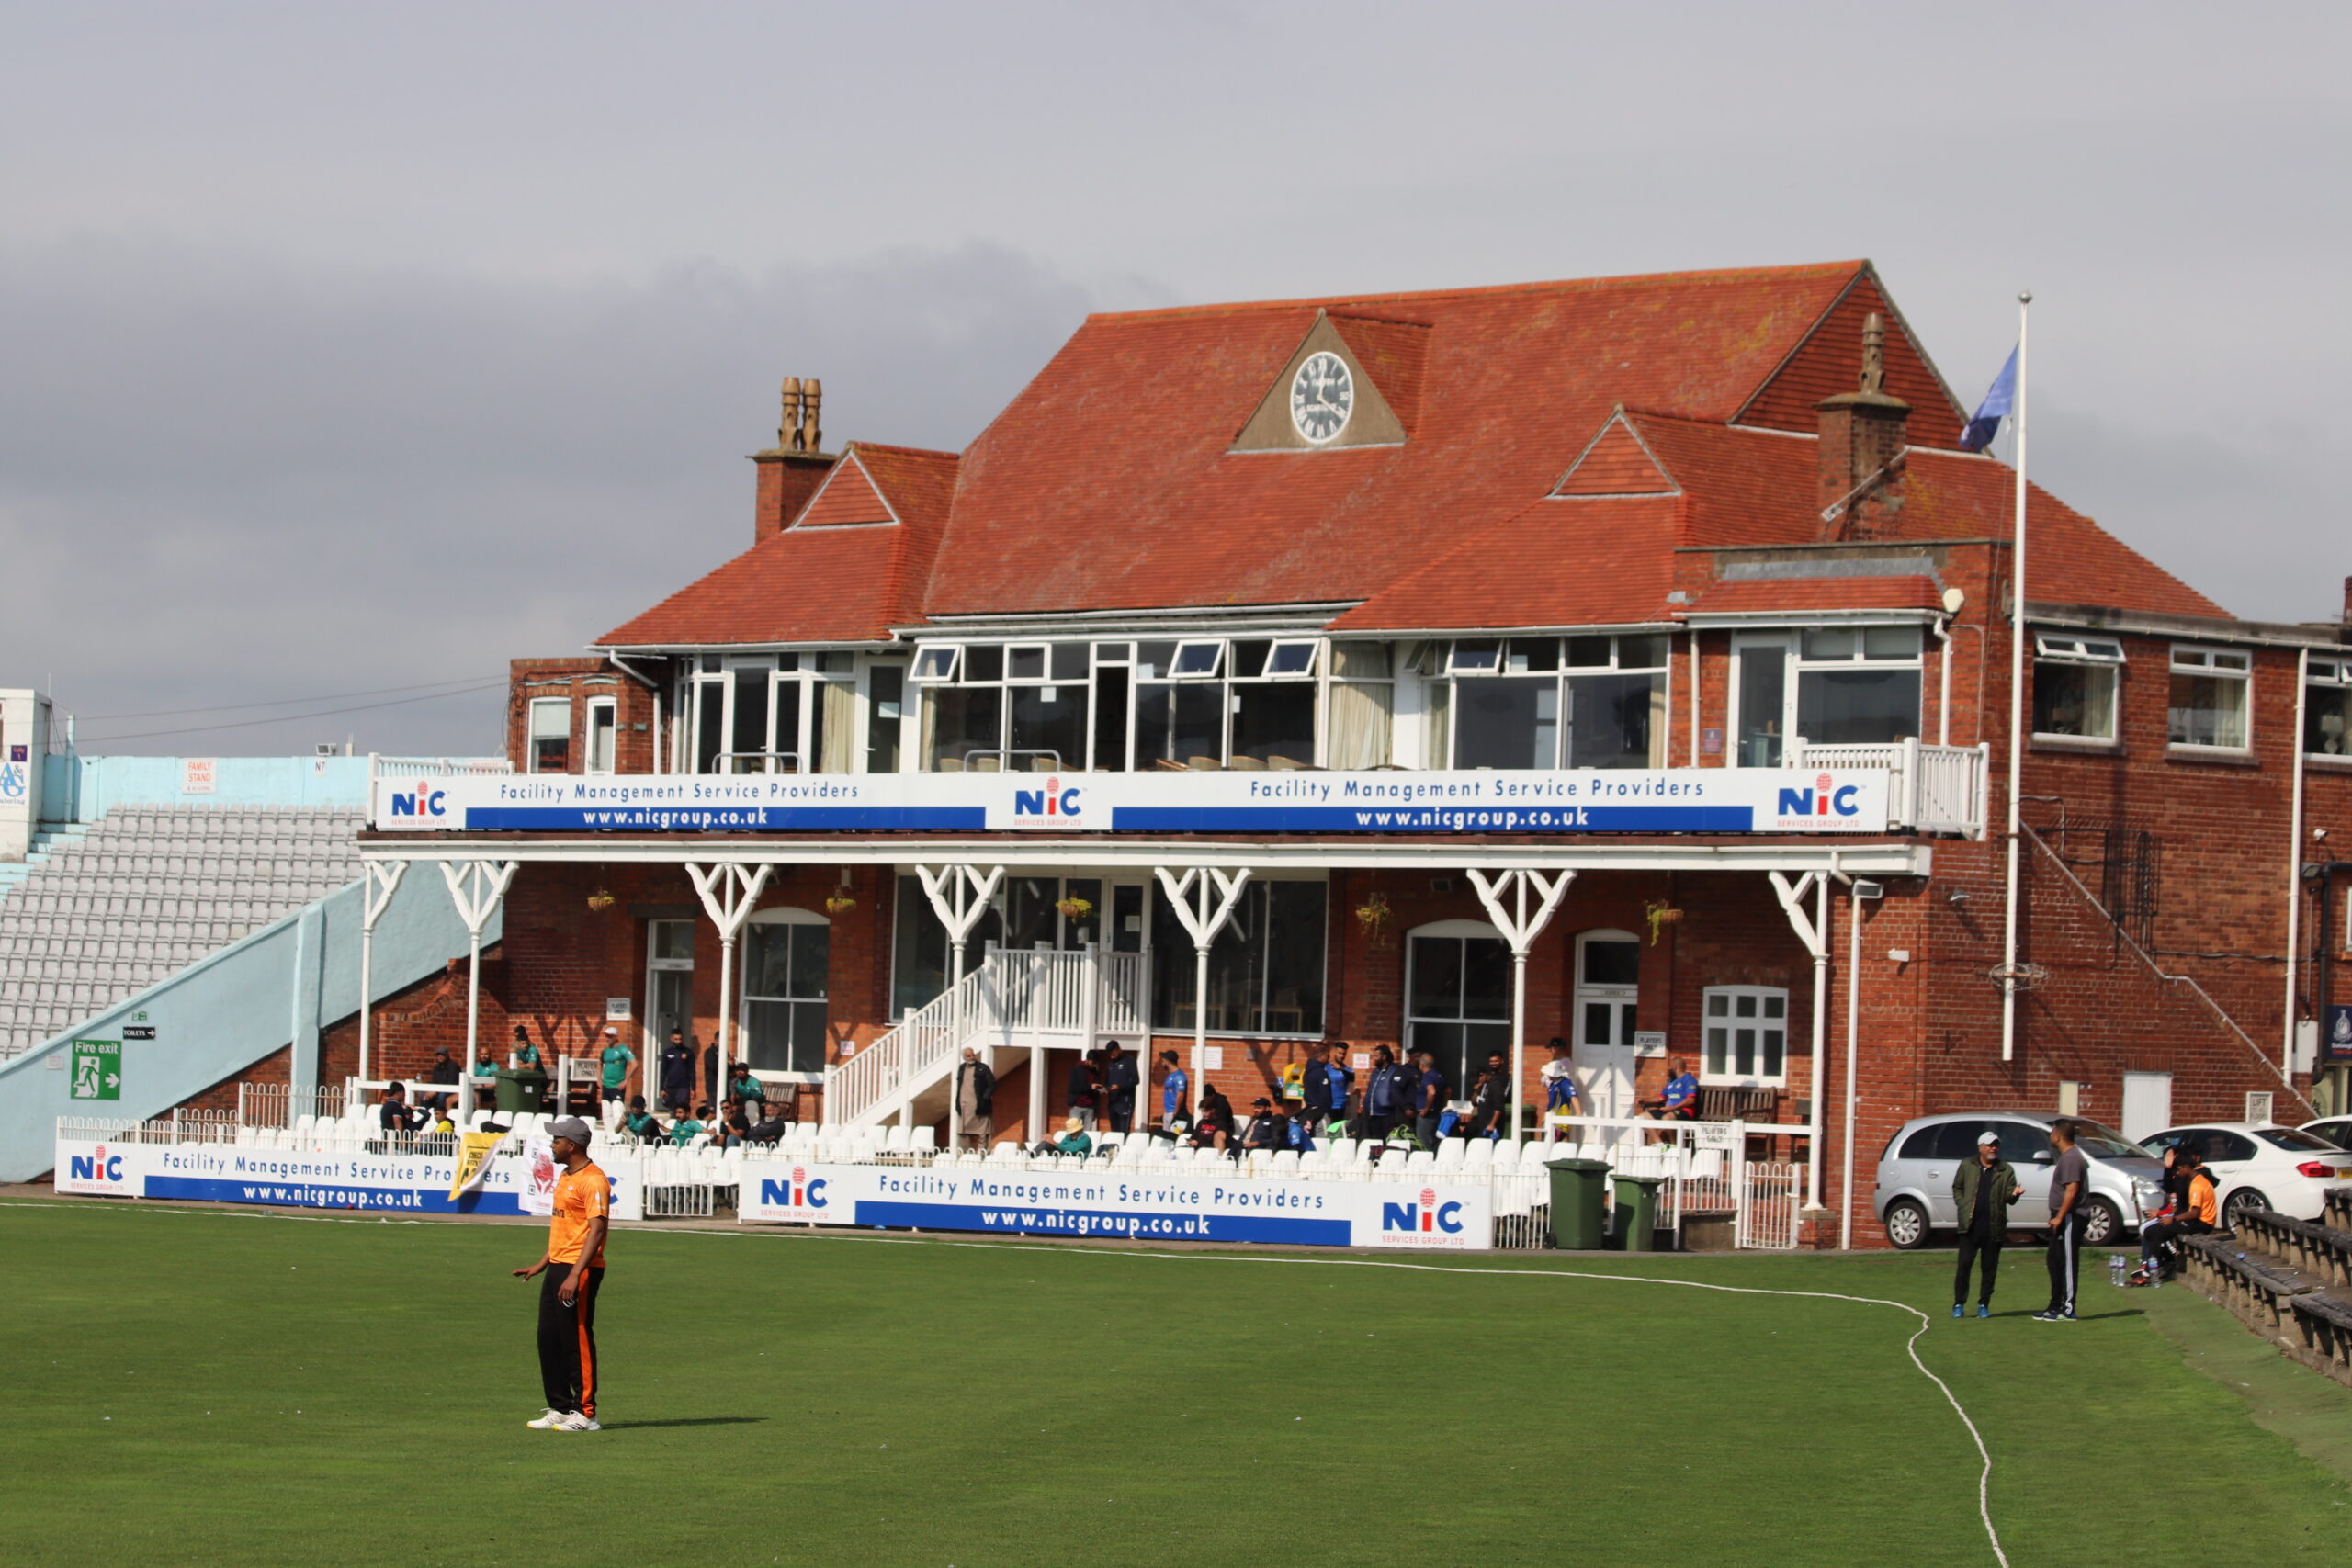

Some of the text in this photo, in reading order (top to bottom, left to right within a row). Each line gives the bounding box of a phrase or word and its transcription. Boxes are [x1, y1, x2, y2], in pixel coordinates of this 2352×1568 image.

[188, 761, 212, 771] FAMILY
[188, 773, 211, 782] STAND
[502, 781, 859, 803] Facility Management Service Providers
[1251, 777, 1703, 802] Facility Management Service Providers
[583, 807, 768, 828] www.nicgroup.co.uk
[1356, 807, 1588, 830] www.nicgroup.co.uk
[75, 1042, 119, 1055] Fire exit
[577, 1062, 598, 1070] PLAYER
[581, 1068, 596, 1077] ONLY
[2252, 1098, 2266, 1106] LIFT
[164, 1153, 225, 1175] Facility
[235, 1156, 340, 1179] Management
[351, 1159, 413, 1180] Service
[424, 1161, 510, 1184] Proers
[243, 1184, 422, 1210] www.nicgroup.co.uk
[880, 1175, 1323, 1208] Facility Management Service Providers
[761, 1210, 830, 1220] SERVICES GROUP LTD
[981, 1210, 1211, 1236] www.nicgroup.co.uk
[1382, 1235, 1464, 1246] SERVICES GROUP LTD
